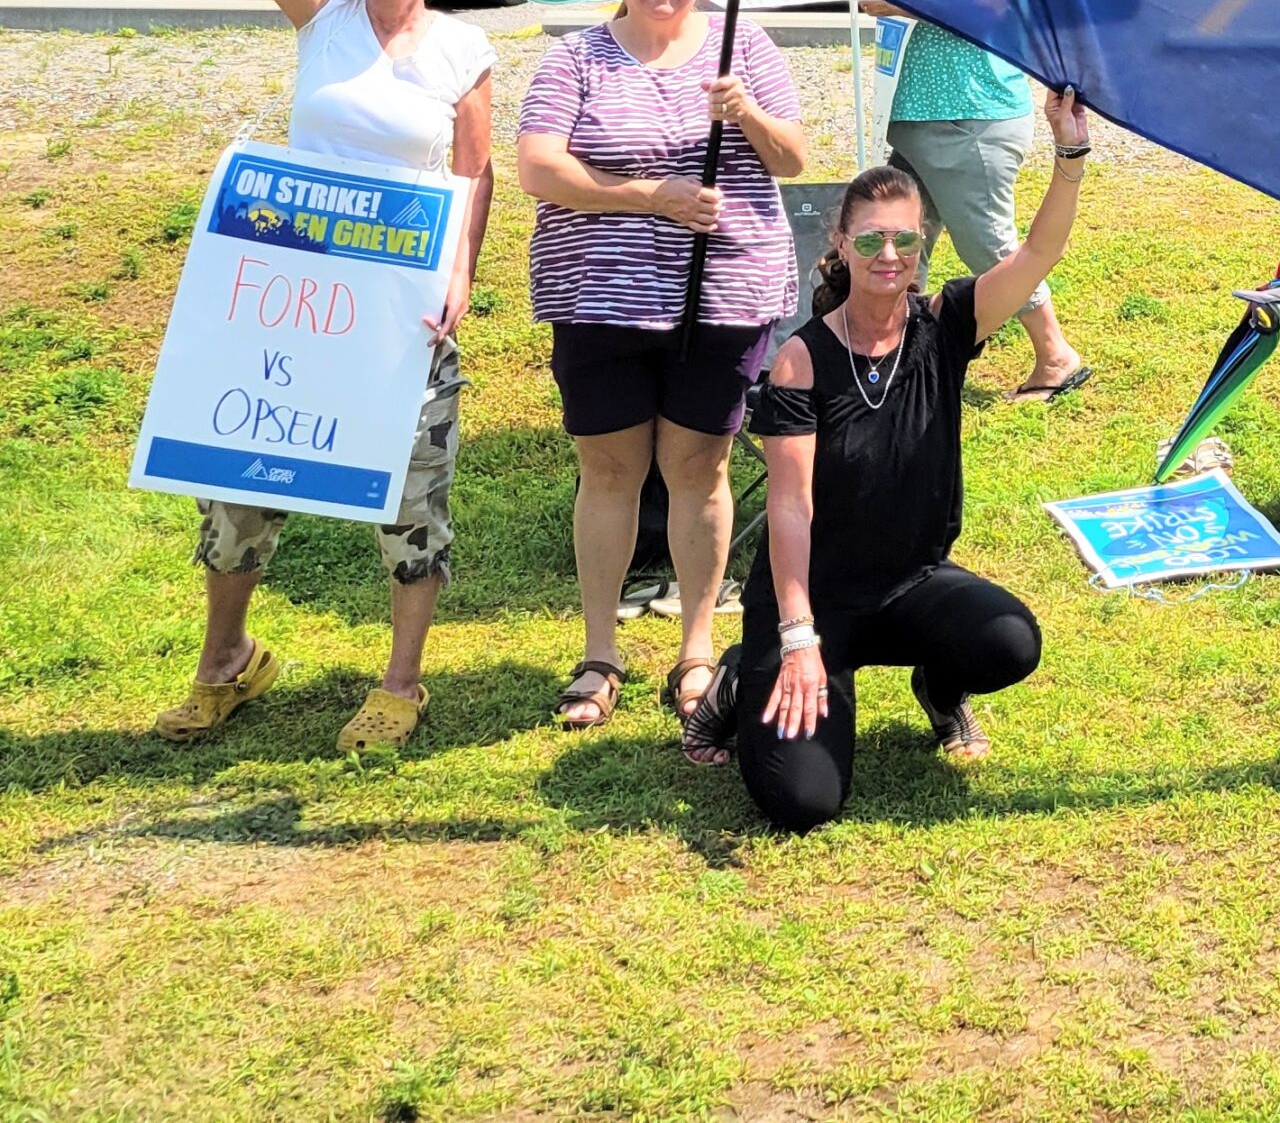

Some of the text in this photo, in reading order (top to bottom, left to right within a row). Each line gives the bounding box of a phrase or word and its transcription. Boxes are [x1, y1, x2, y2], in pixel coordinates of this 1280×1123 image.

[236, 169, 382, 219] ON STRIKE!
[293, 211, 430, 258] EN GRÈVE!
[226, 255, 356, 336] FORD
[213, 388, 339, 452] OPSEU
[1100, 506, 1217, 539] STRIKE
